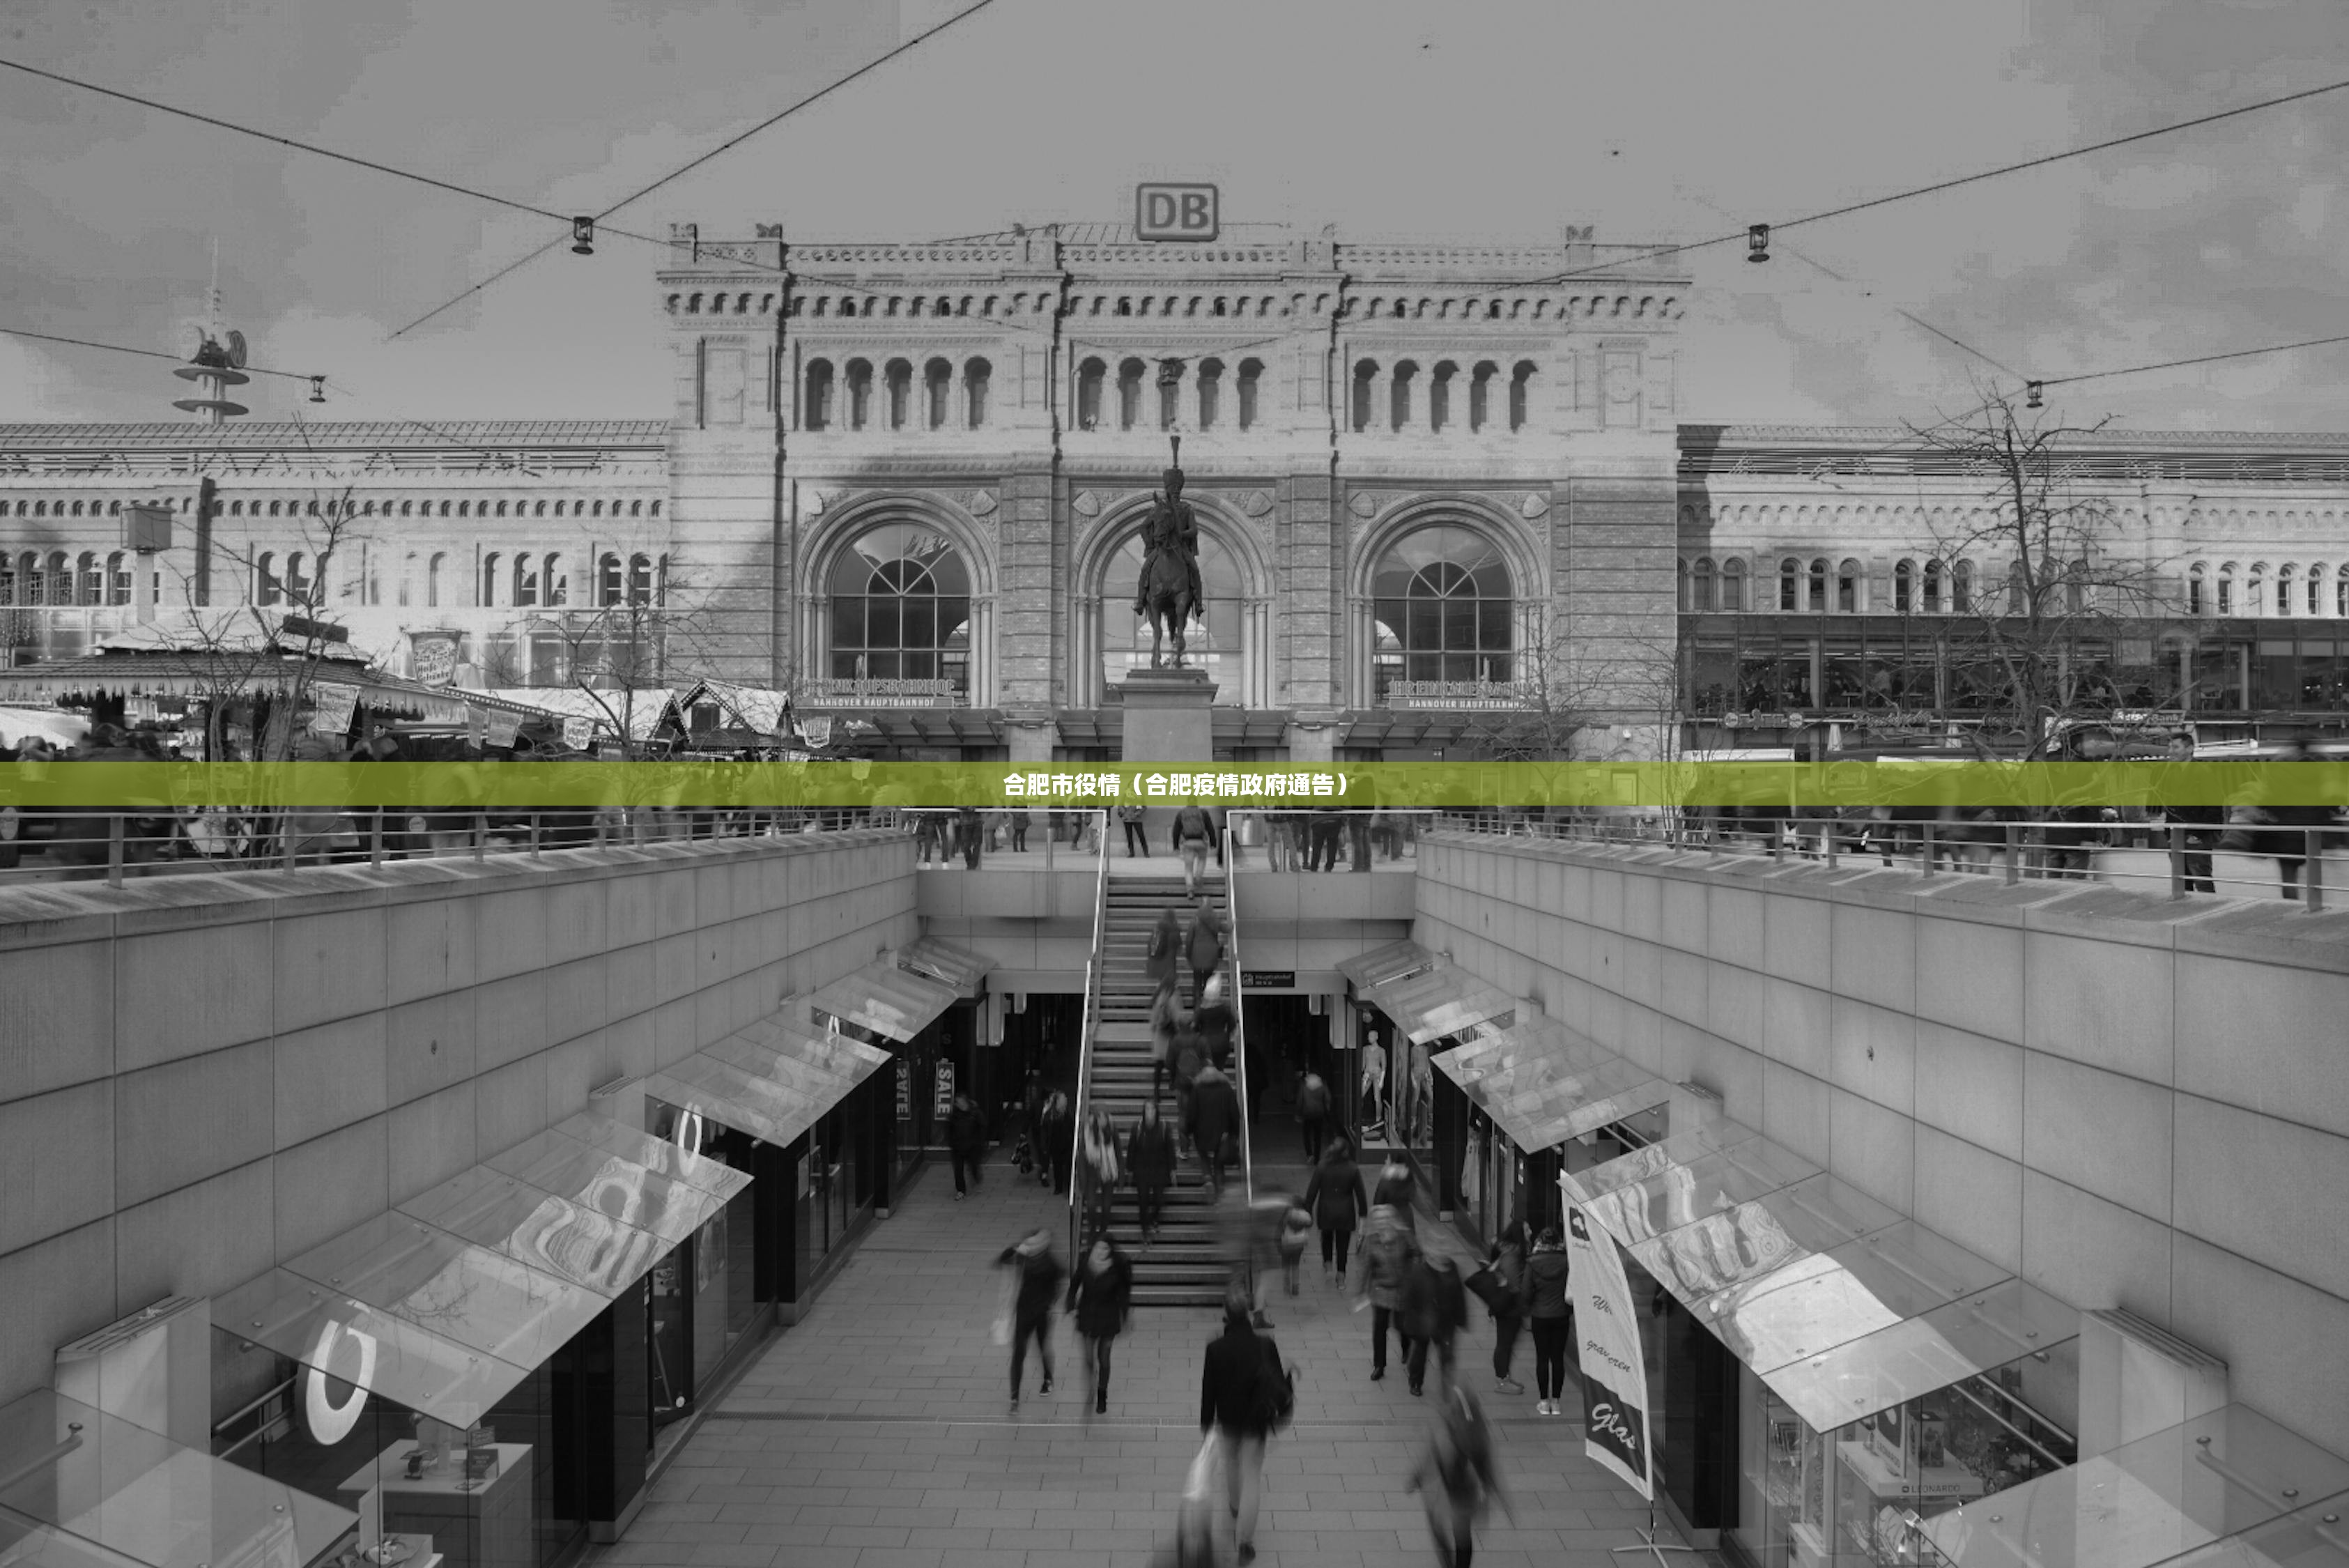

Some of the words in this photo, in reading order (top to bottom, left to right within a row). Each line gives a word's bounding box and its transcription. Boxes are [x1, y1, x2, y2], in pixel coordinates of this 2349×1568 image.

[1147, 192, 1209, 230] DB
[813, 698, 861, 707] HANNOVER
[863, 698, 934, 707] HAUPTBAHNHOF
[1408, 700, 1457, 708] HANNOVER
[937, 1068, 953, 1114] SALE
